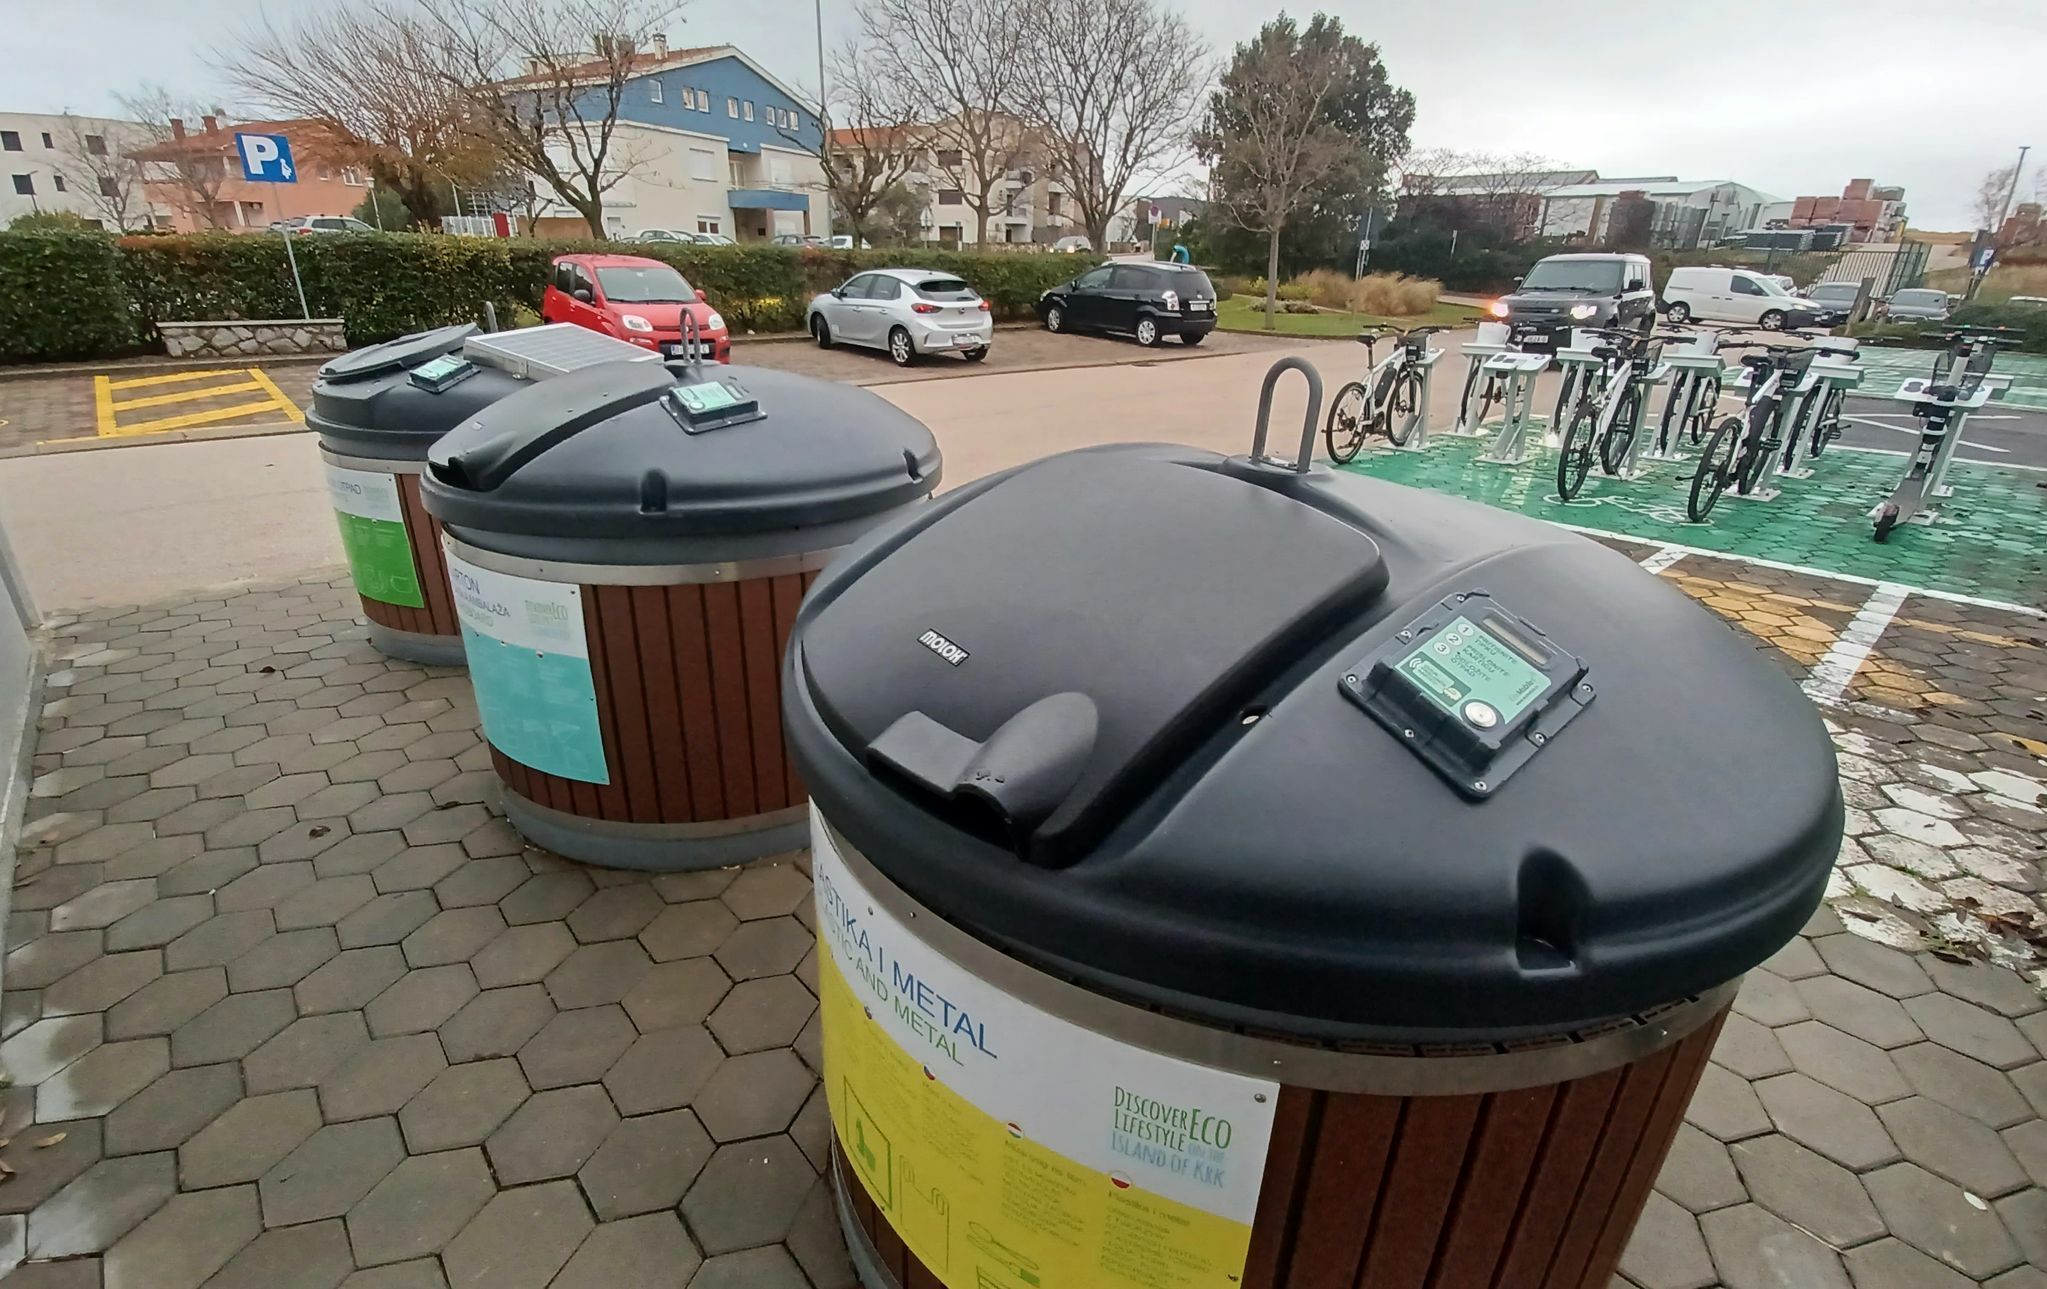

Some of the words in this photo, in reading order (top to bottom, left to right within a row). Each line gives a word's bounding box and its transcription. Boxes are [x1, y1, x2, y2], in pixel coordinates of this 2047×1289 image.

[241, 135, 279, 174] P
[1980, 249, 1994, 265] P
[1436, 644, 1447, 653] 3
[1448, 635, 1459, 643] 2
[856, 959, 889, 1002] AND
[894, 996, 965, 1067] METAL
[893, 960, 998, 1059] METAL
[1114, 1086, 1188, 1131] DISCOVER
[1114, 1109, 1187, 1152] LIFESTYLE
[1111, 1130, 1167, 1168] ISLAND
[1170, 1154, 1189, 1176] OF
[1193, 1159, 1226, 1189] KRK
